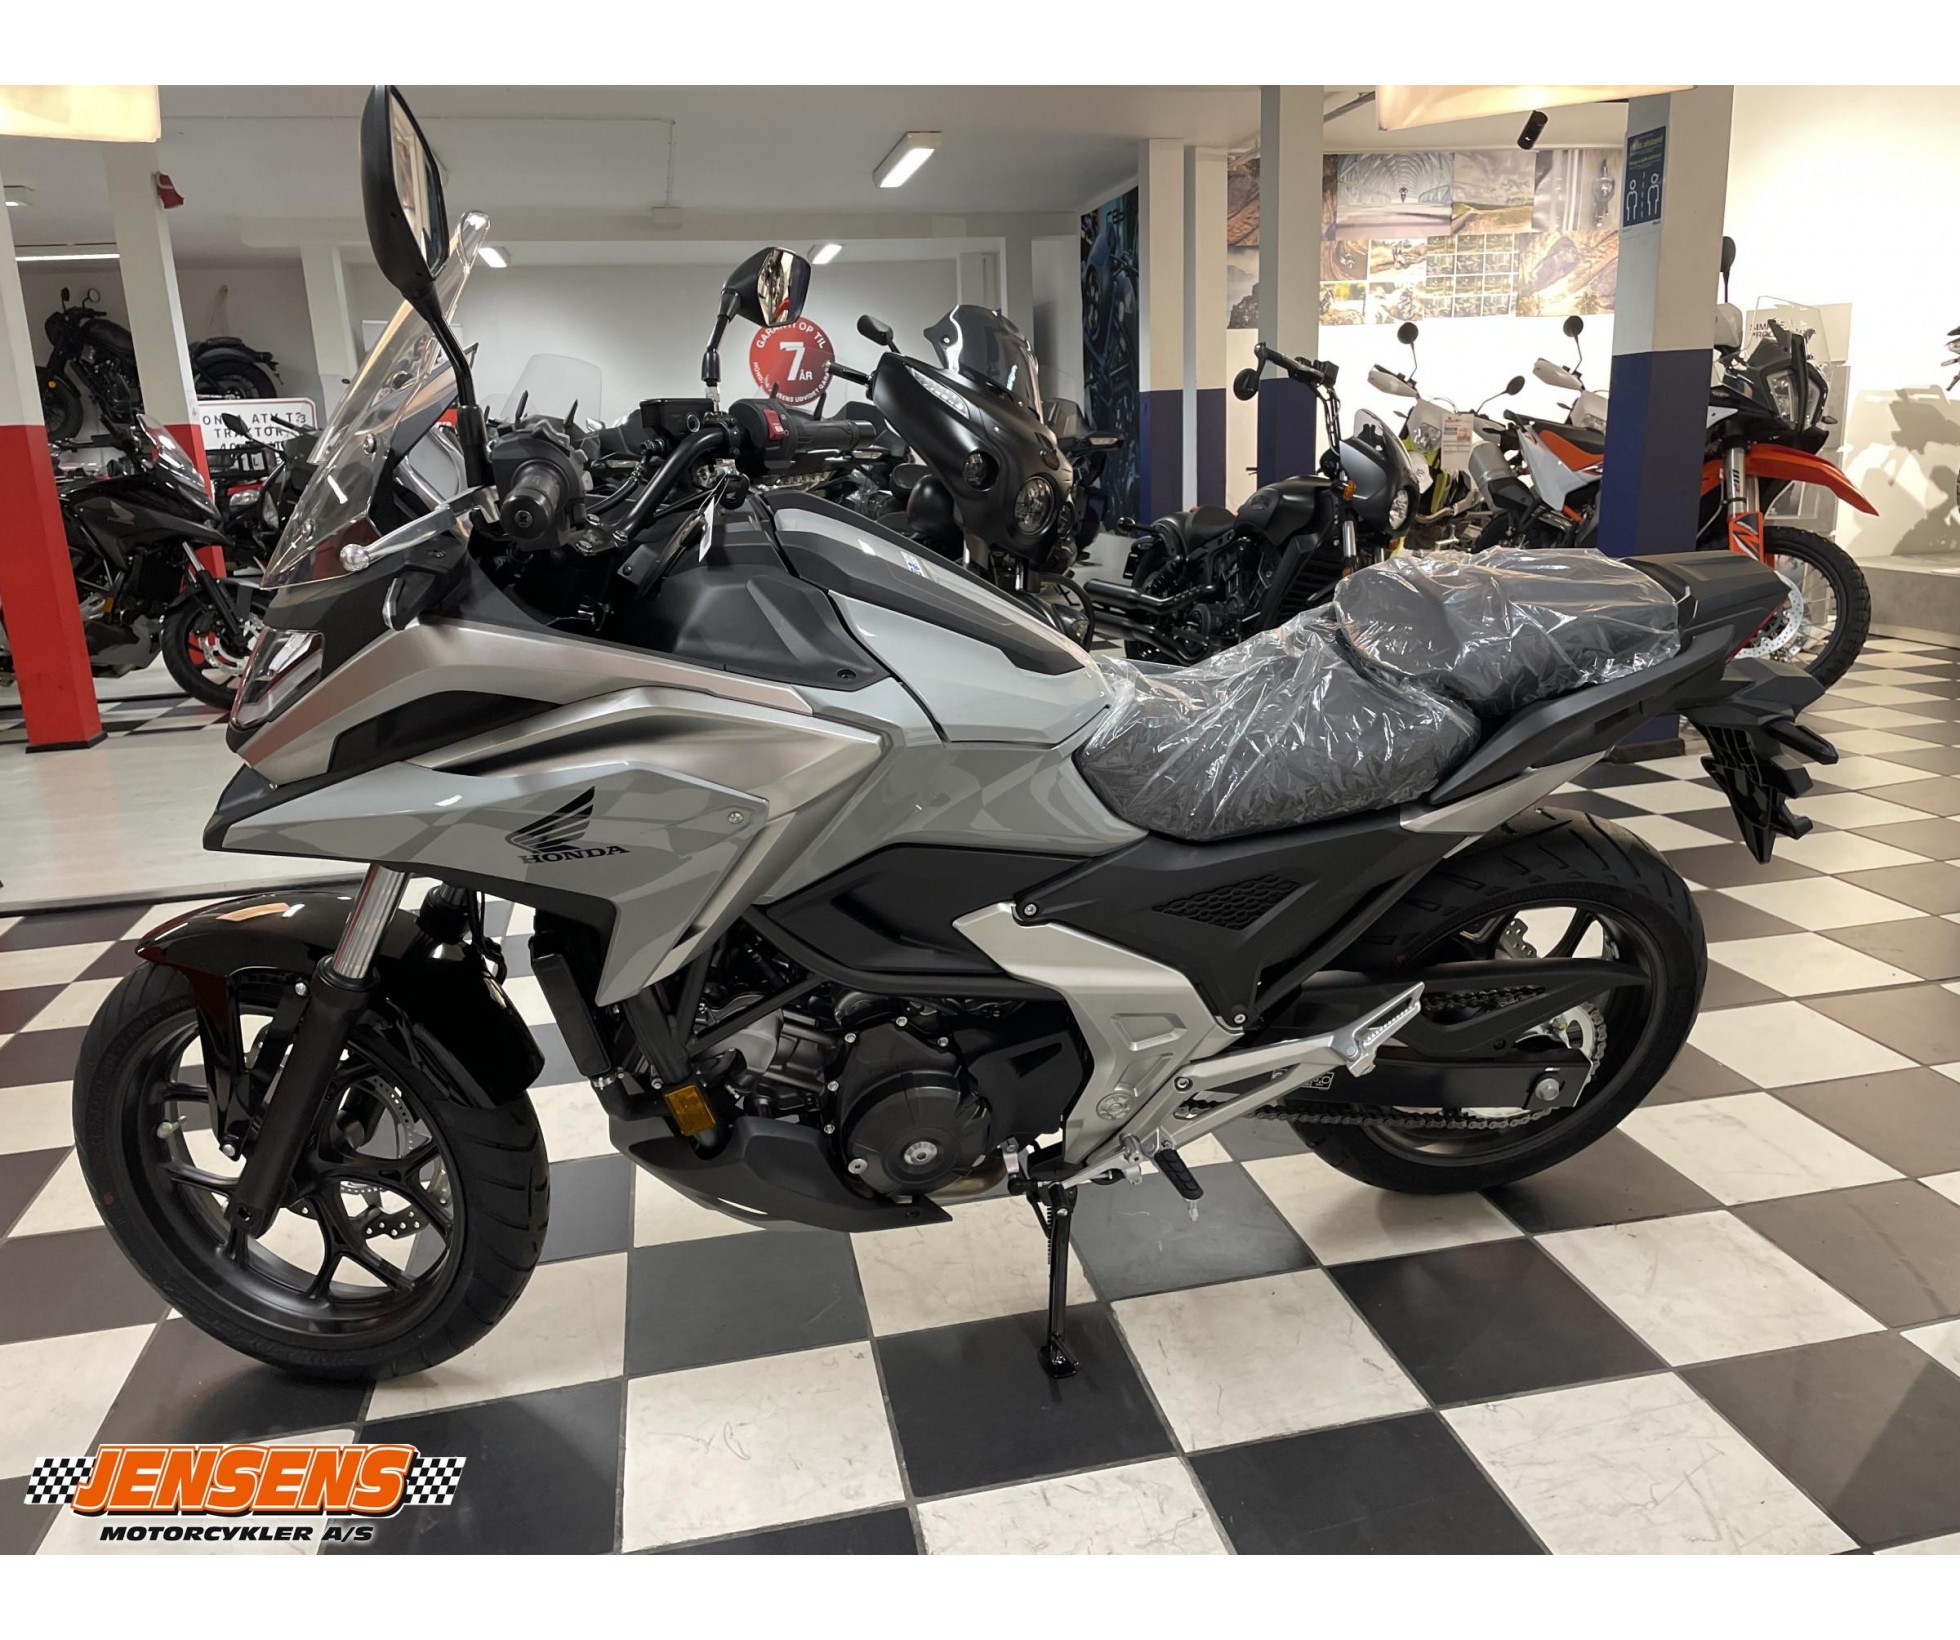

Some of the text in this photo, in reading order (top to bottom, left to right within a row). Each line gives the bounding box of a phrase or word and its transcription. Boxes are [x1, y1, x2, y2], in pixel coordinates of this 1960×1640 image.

[798, 321, 814, 333] OP
[814, 331, 826, 349] TIL
[779, 341, 806, 381] 7
[799, 368, 813, 381] ÅR
[518, 845, 630, 864] HONDA
